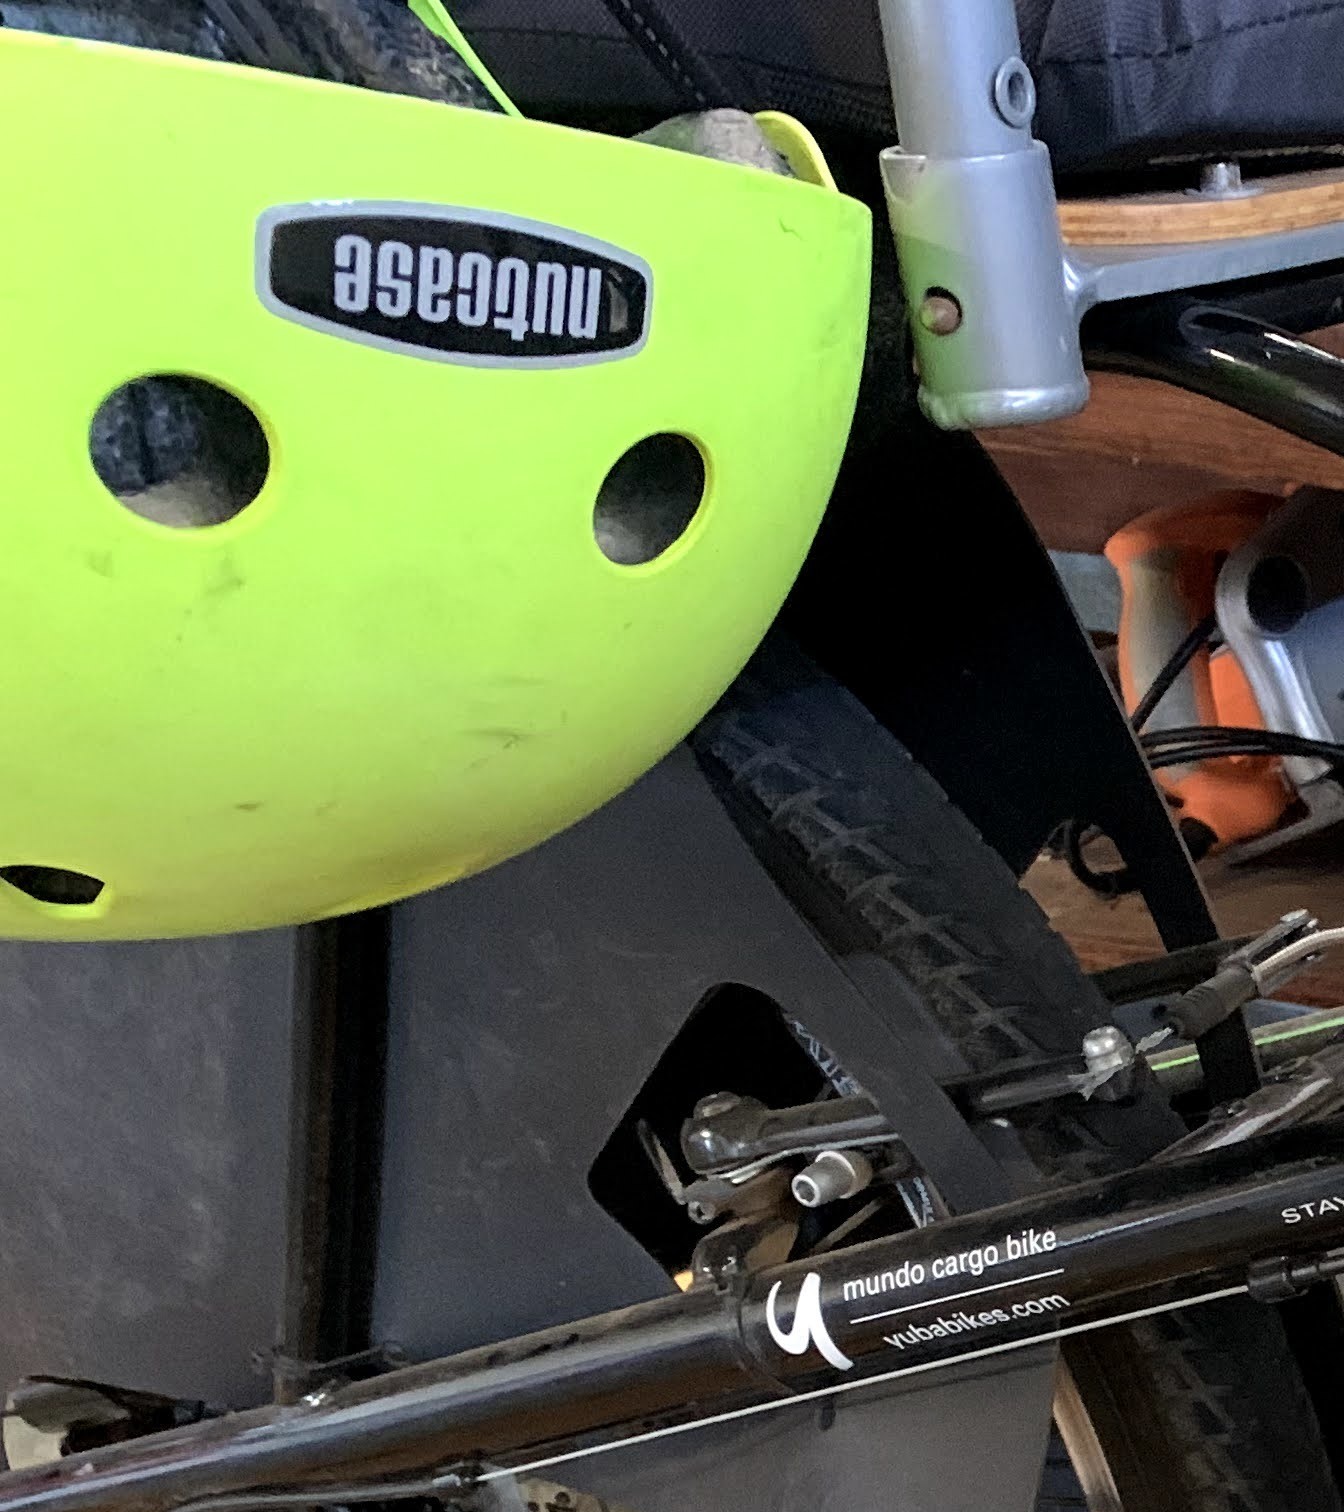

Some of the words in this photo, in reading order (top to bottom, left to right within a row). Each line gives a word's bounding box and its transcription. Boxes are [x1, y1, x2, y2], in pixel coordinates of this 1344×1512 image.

[334, 234, 602, 341] nutcase
[843, 1261, 925, 1301] mundo
[932, 1245, 999, 1276] cargo
[1007, 1228, 1058, 1260] bike
[884, 1293, 1071, 1350] yubabikes.com
